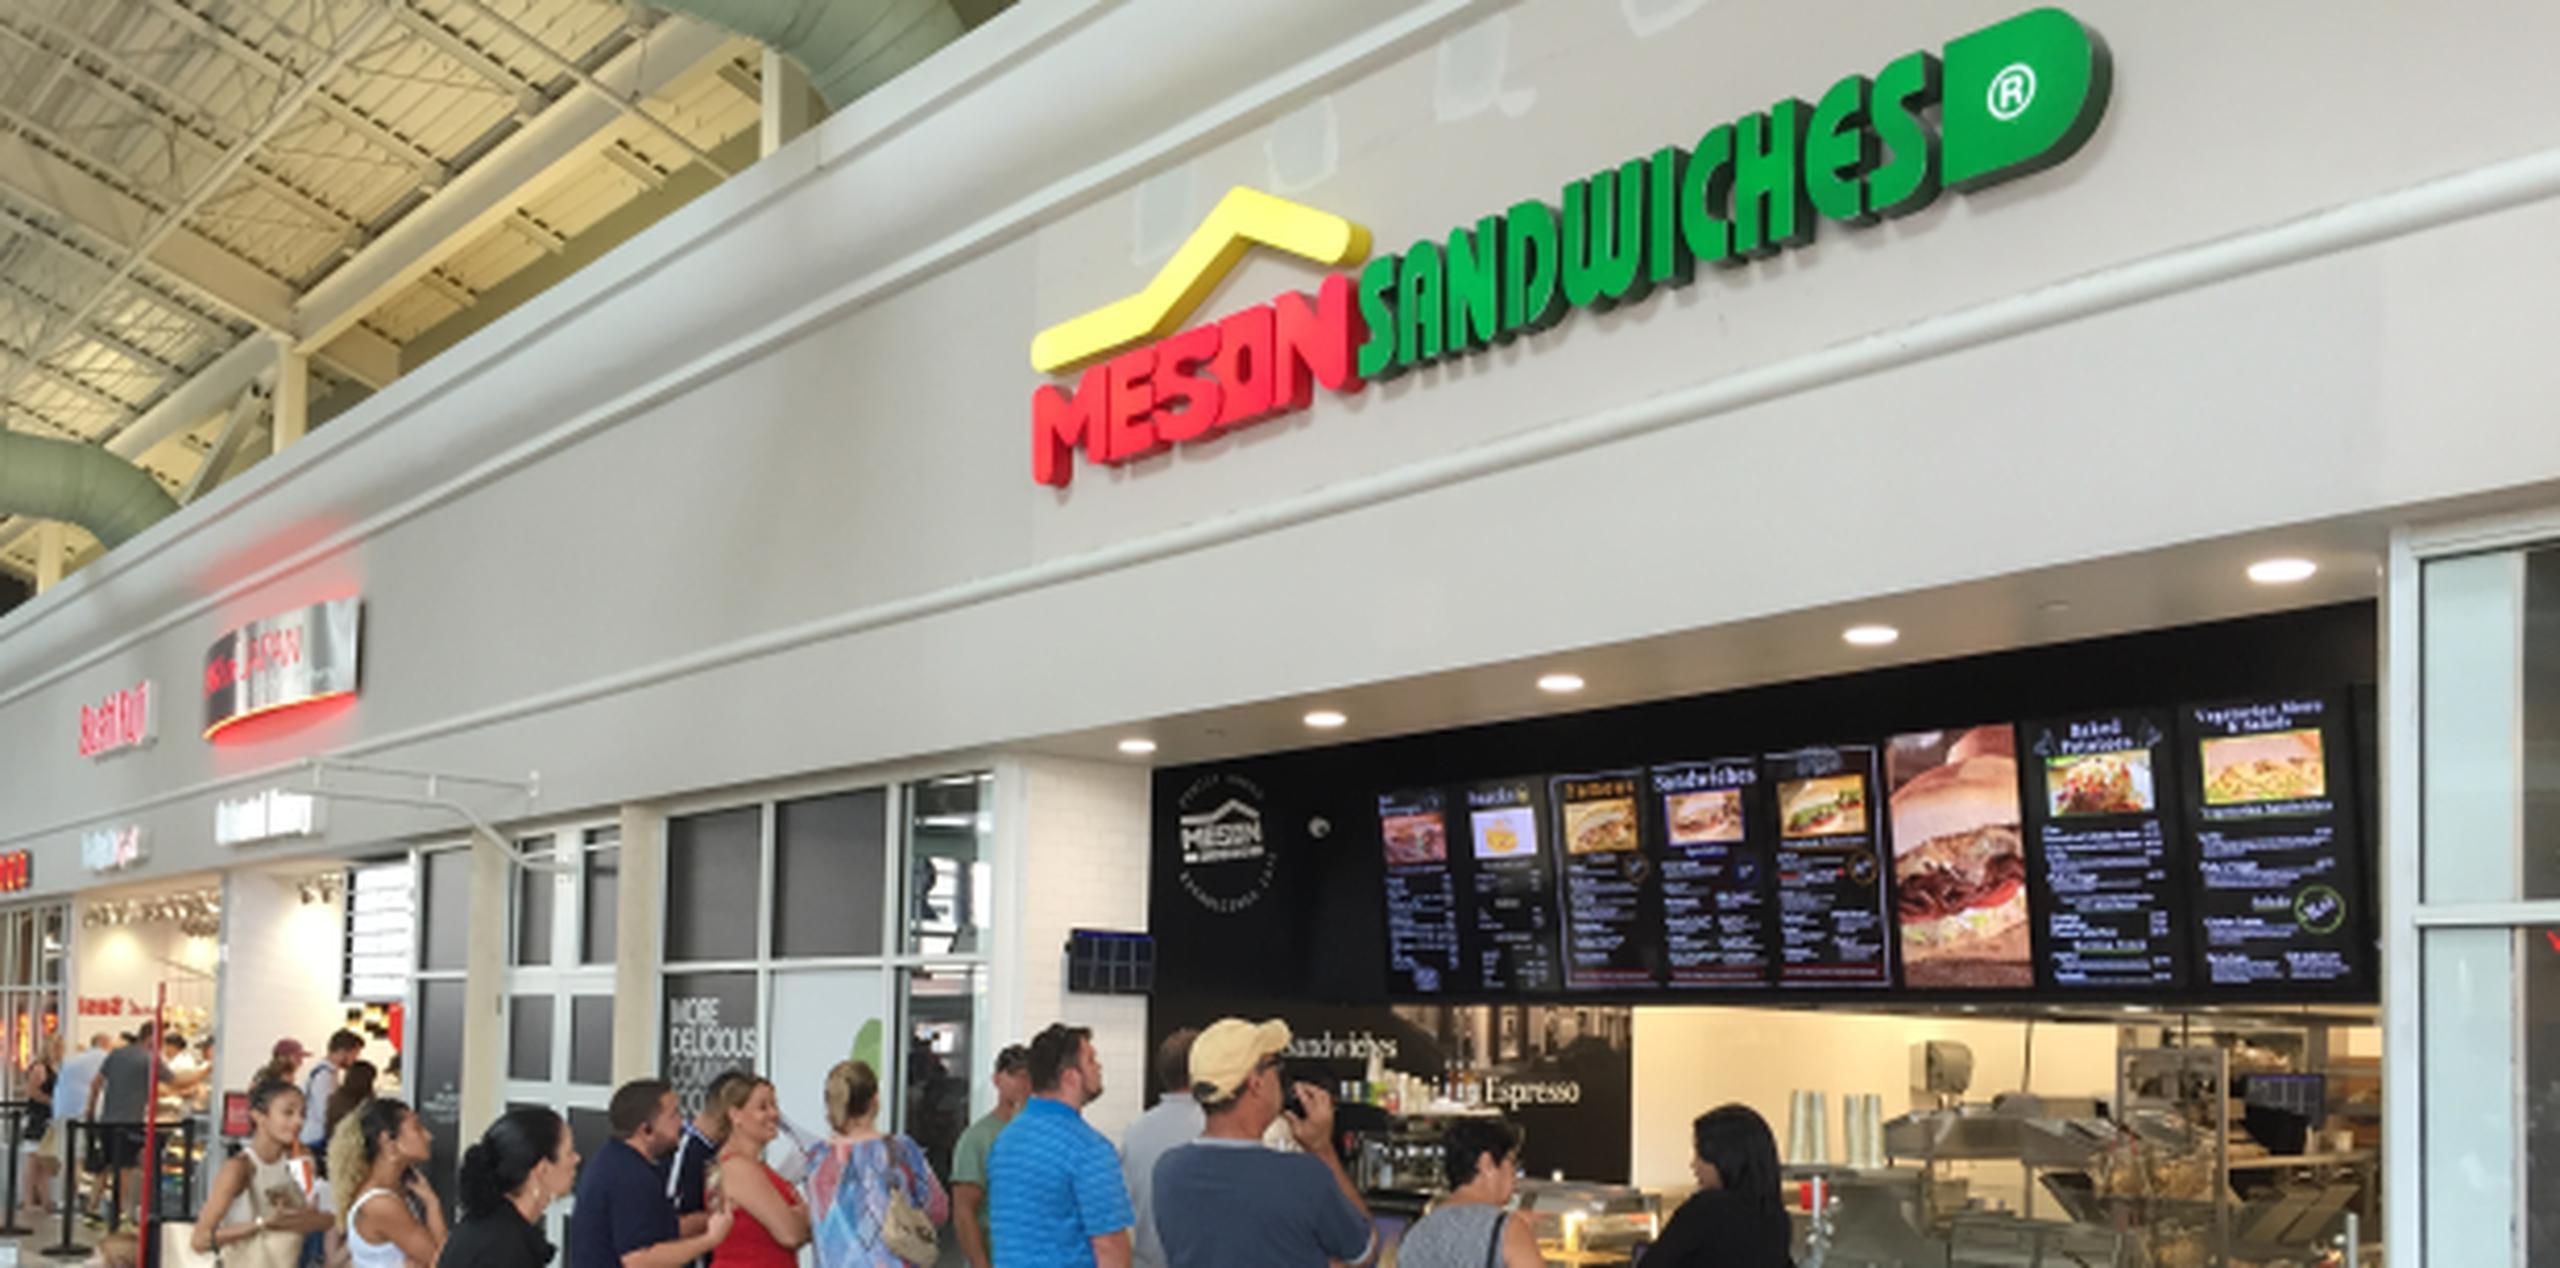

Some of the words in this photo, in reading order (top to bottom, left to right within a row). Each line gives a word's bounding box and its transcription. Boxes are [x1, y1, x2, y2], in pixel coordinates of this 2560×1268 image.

[1032, 272, 1363, 487] MESON
[1358, 50, 1942, 378] SANDWICHES
[670, 997, 720, 1025] MORE
[670, 1026, 758, 1059] DELICIOUS
[1485, 1075, 1581, 1111] Espresso
